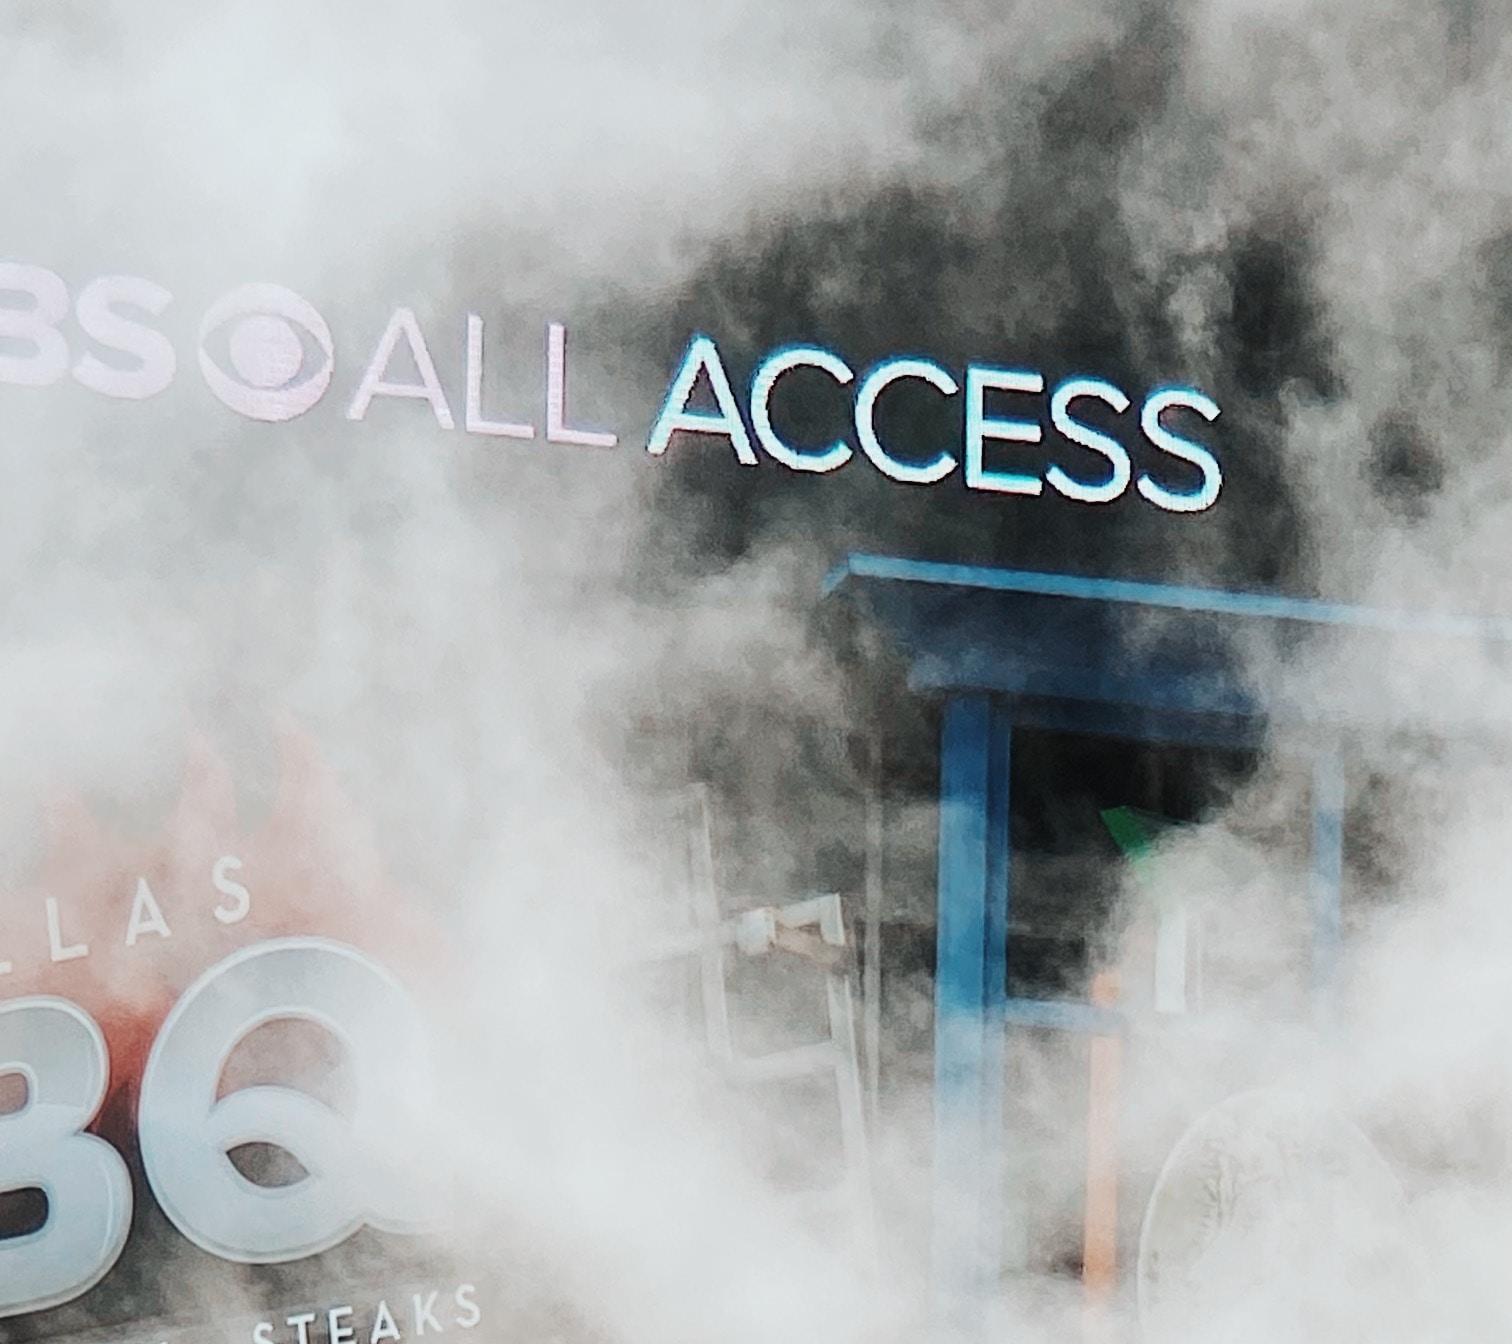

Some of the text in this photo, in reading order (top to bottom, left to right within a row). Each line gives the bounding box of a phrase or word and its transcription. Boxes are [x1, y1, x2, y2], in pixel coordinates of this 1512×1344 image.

[346, 307, 618, 447] ALL
[646, 332, 1224, 513] ACCESS
[0, 855, 251, 974] LAS
